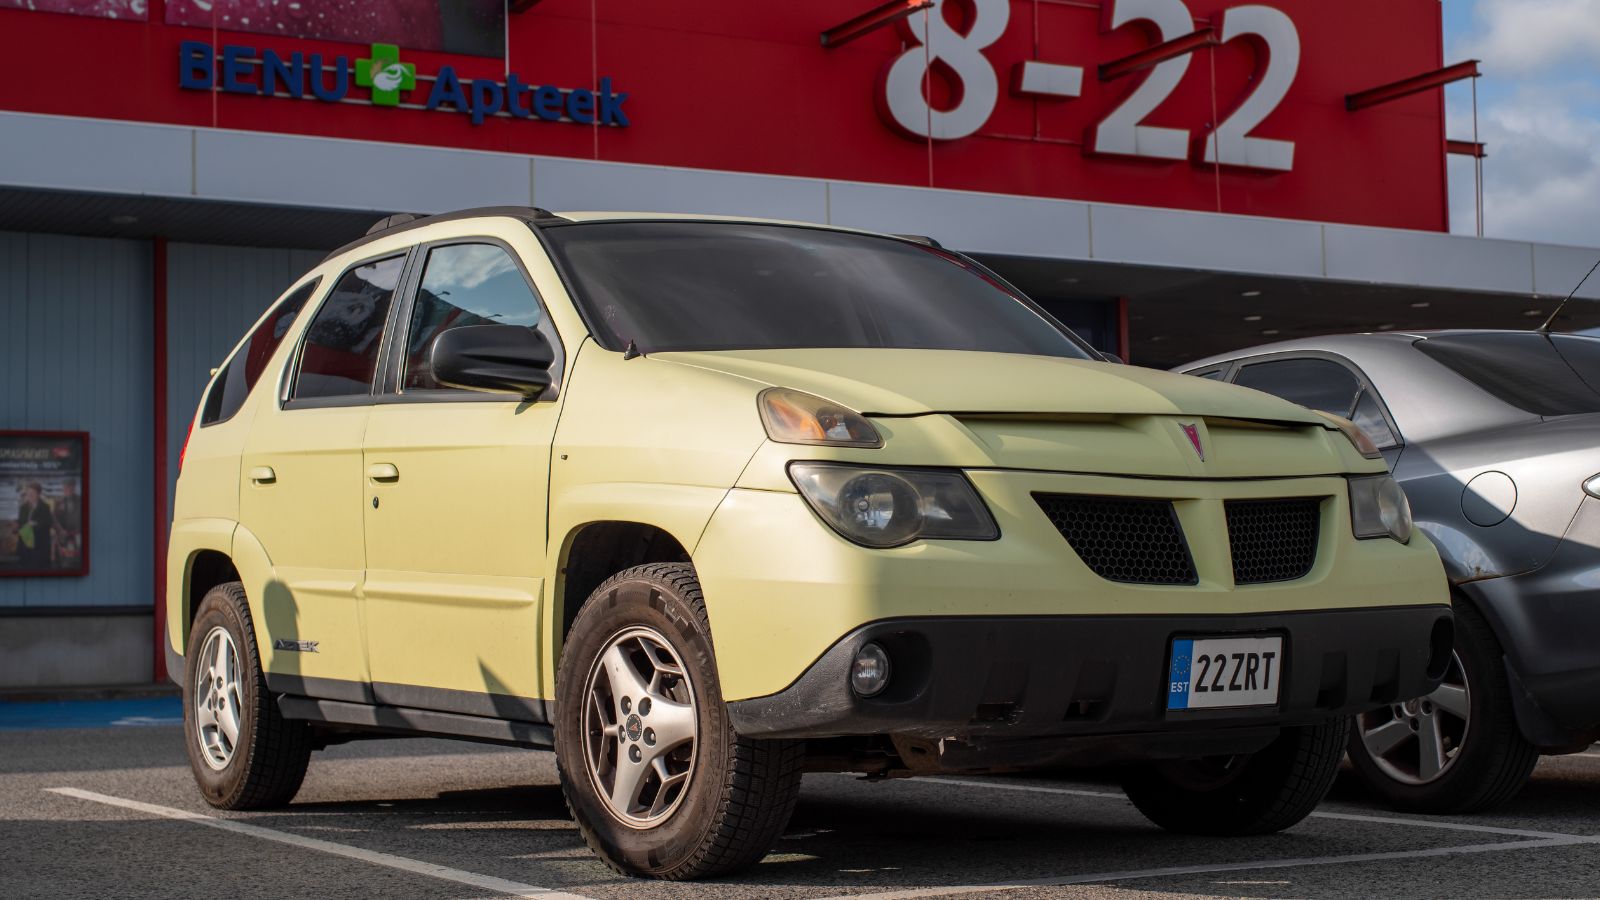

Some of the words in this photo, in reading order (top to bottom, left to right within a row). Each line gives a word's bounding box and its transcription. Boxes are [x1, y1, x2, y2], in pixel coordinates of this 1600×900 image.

[179, 40, 348, 102] BENU
[426, 65, 630, 126] Apteek
[886, 0, 1300, 170] 8-22
[1171, 681, 1190, 693] EST
[1195, 652, 1276, 693] 22ZRT
